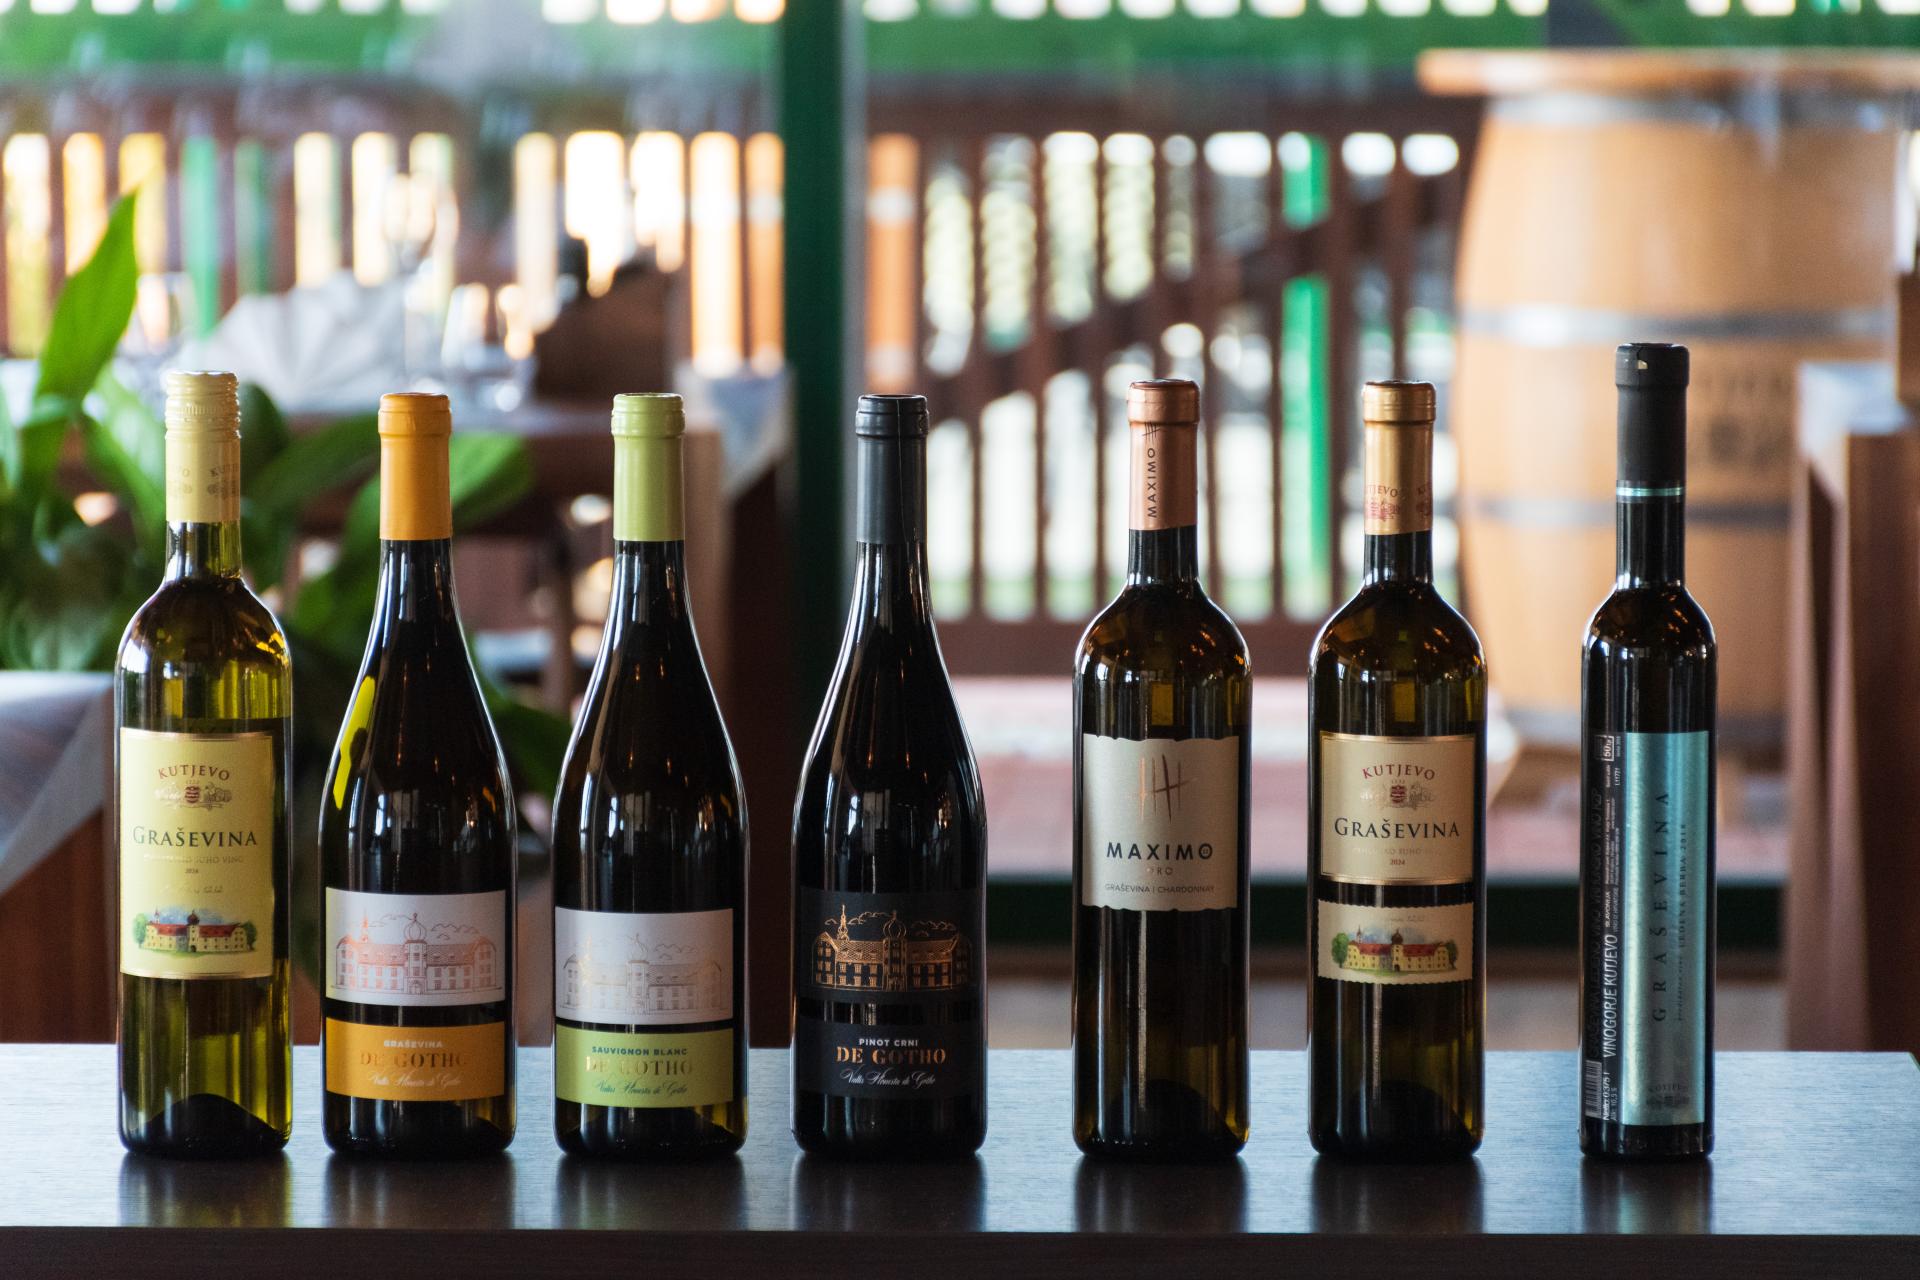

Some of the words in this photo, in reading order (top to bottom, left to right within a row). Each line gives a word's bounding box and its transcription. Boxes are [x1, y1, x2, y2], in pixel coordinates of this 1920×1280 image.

[1147, 447, 1157, 518] MAXIMO
[158, 764, 230, 781] KUTJEVO
[1362, 763, 1436, 781] KUTJEVO
[132, 826, 257, 848] GRAŠEVINA
[1334, 817, 1460, 839] GRAŠEVINA
[1106, 841, 1213, 861] MAXIMO
[1105, 883, 1151, 893] GRAŠEVINA
[1157, 885, 1215, 894] CHARDONNAY
[1650, 793, 1669, 1022] GRAŠEVINA
[1603, 934, 1618, 986] KUTJEVO
[1603, 987, 1618, 1058] VINOGORJE
[592, 1046, 650, 1056] SAUVIGNON
[653, 1047, 688, 1056] BLANC
[858, 1038, 890, 1047] PINOT
[893, 1039, 919, 1047] CRNI
[836, 1046, 863, 1064] DE
[871, 1048, 947, 1065] GOTHO
